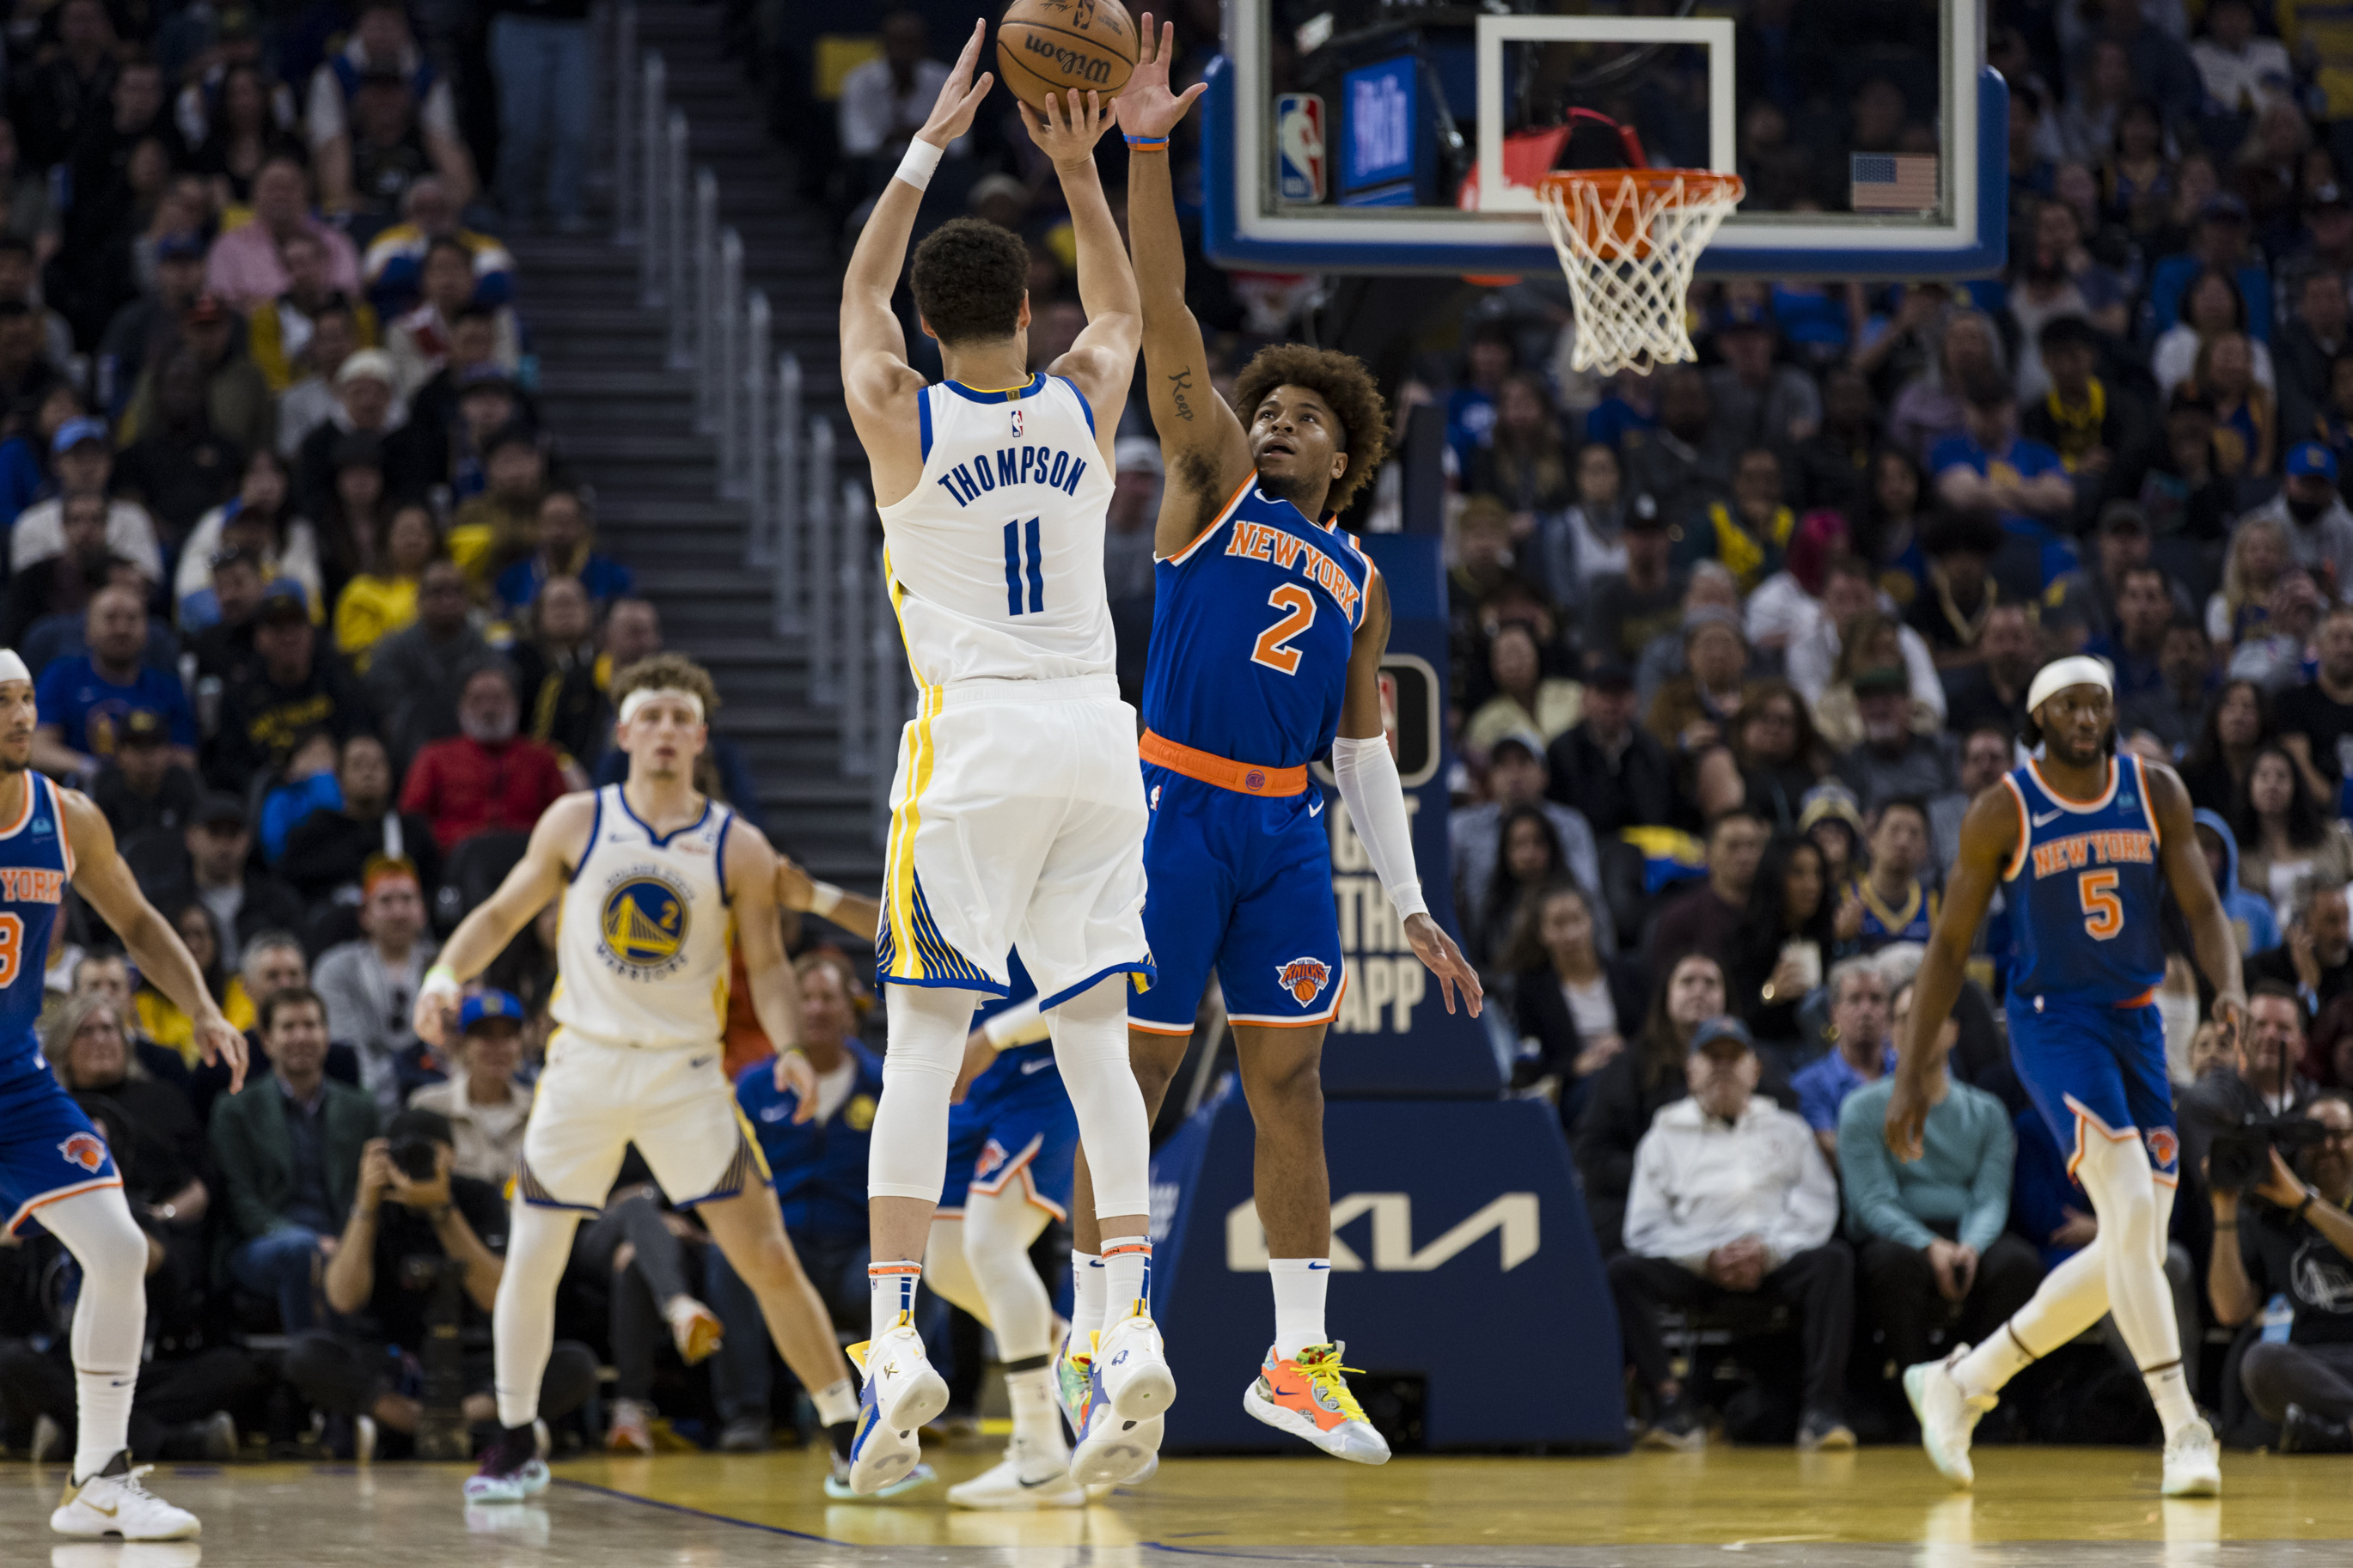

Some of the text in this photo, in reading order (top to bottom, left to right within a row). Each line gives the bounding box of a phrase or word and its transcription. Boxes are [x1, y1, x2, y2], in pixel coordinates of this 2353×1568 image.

[1024, 33, 1112, 84] Wilson
[1168, 365, 1194, 421] Keep
[938, 446, 1087, 508] THOMPSON
[1004, 516, 1044, 616] 11
[1224, 520, 1360, 625] NEW YORK
[1250, 582, 1317, 676] 2
[2032, 828, 2154, 880] NEW YORK
[0, 867, 64, 905] YORK
[660, 900, 680, 930] 2
[1333, 875, 1421, 953] TH
[2078, 867, 2124, 942] 5
[1281, 963, 1327, 983] KNICKS
[1334, 957, 1426, 1033] APP
